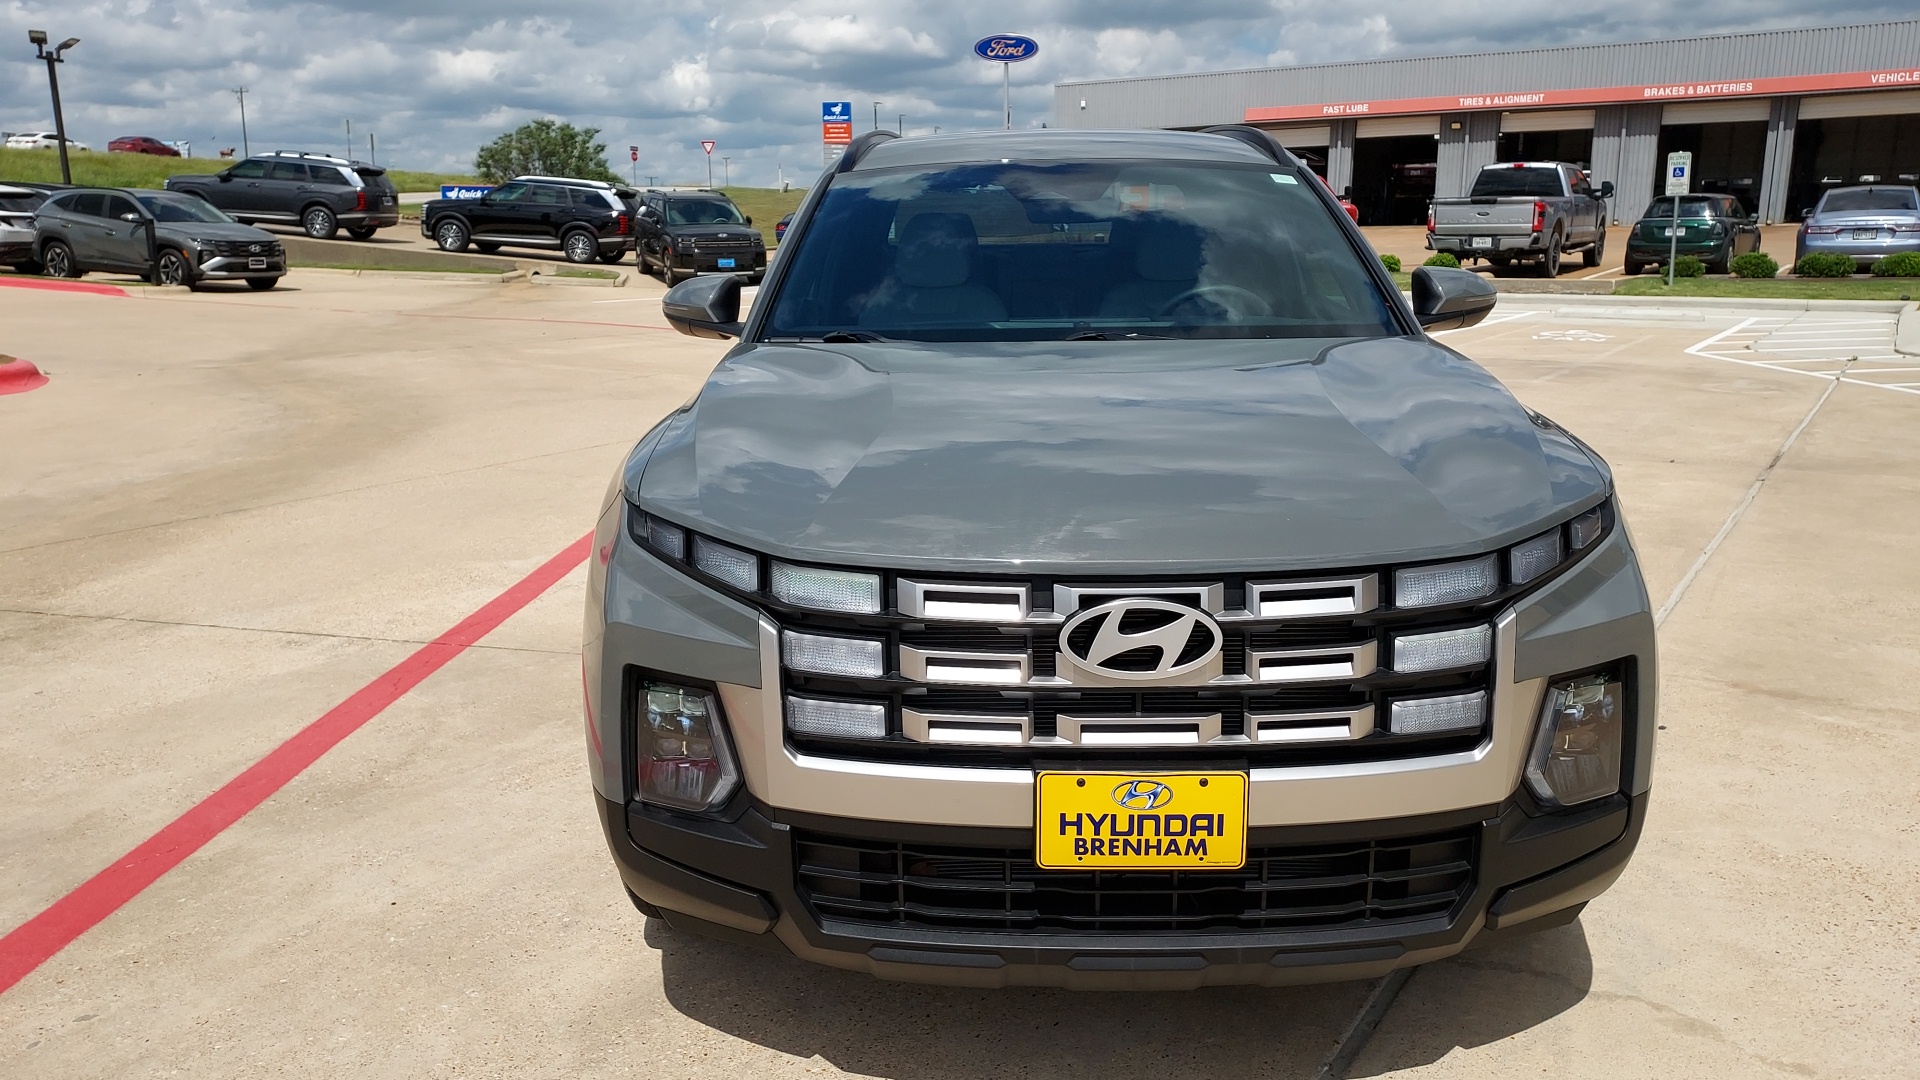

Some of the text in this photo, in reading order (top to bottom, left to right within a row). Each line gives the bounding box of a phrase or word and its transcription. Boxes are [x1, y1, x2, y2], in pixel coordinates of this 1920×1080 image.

[987, 39, 1026, 56] Ford
[1871, 71, 1920, 84] VEHICLE
[1644, 82, 1753, 97] BRAKES & BATTERIES
[1459, 94, 1545, 106] TIRES & ALIGNMENT
[1323, 103, 1369, 114] FAST LUBE
[459, 189, 482, 198] Quick
[1059, 813, 1224, 837] HYUNDAI
[1074, 838, 1208, 856] BRENHAM
